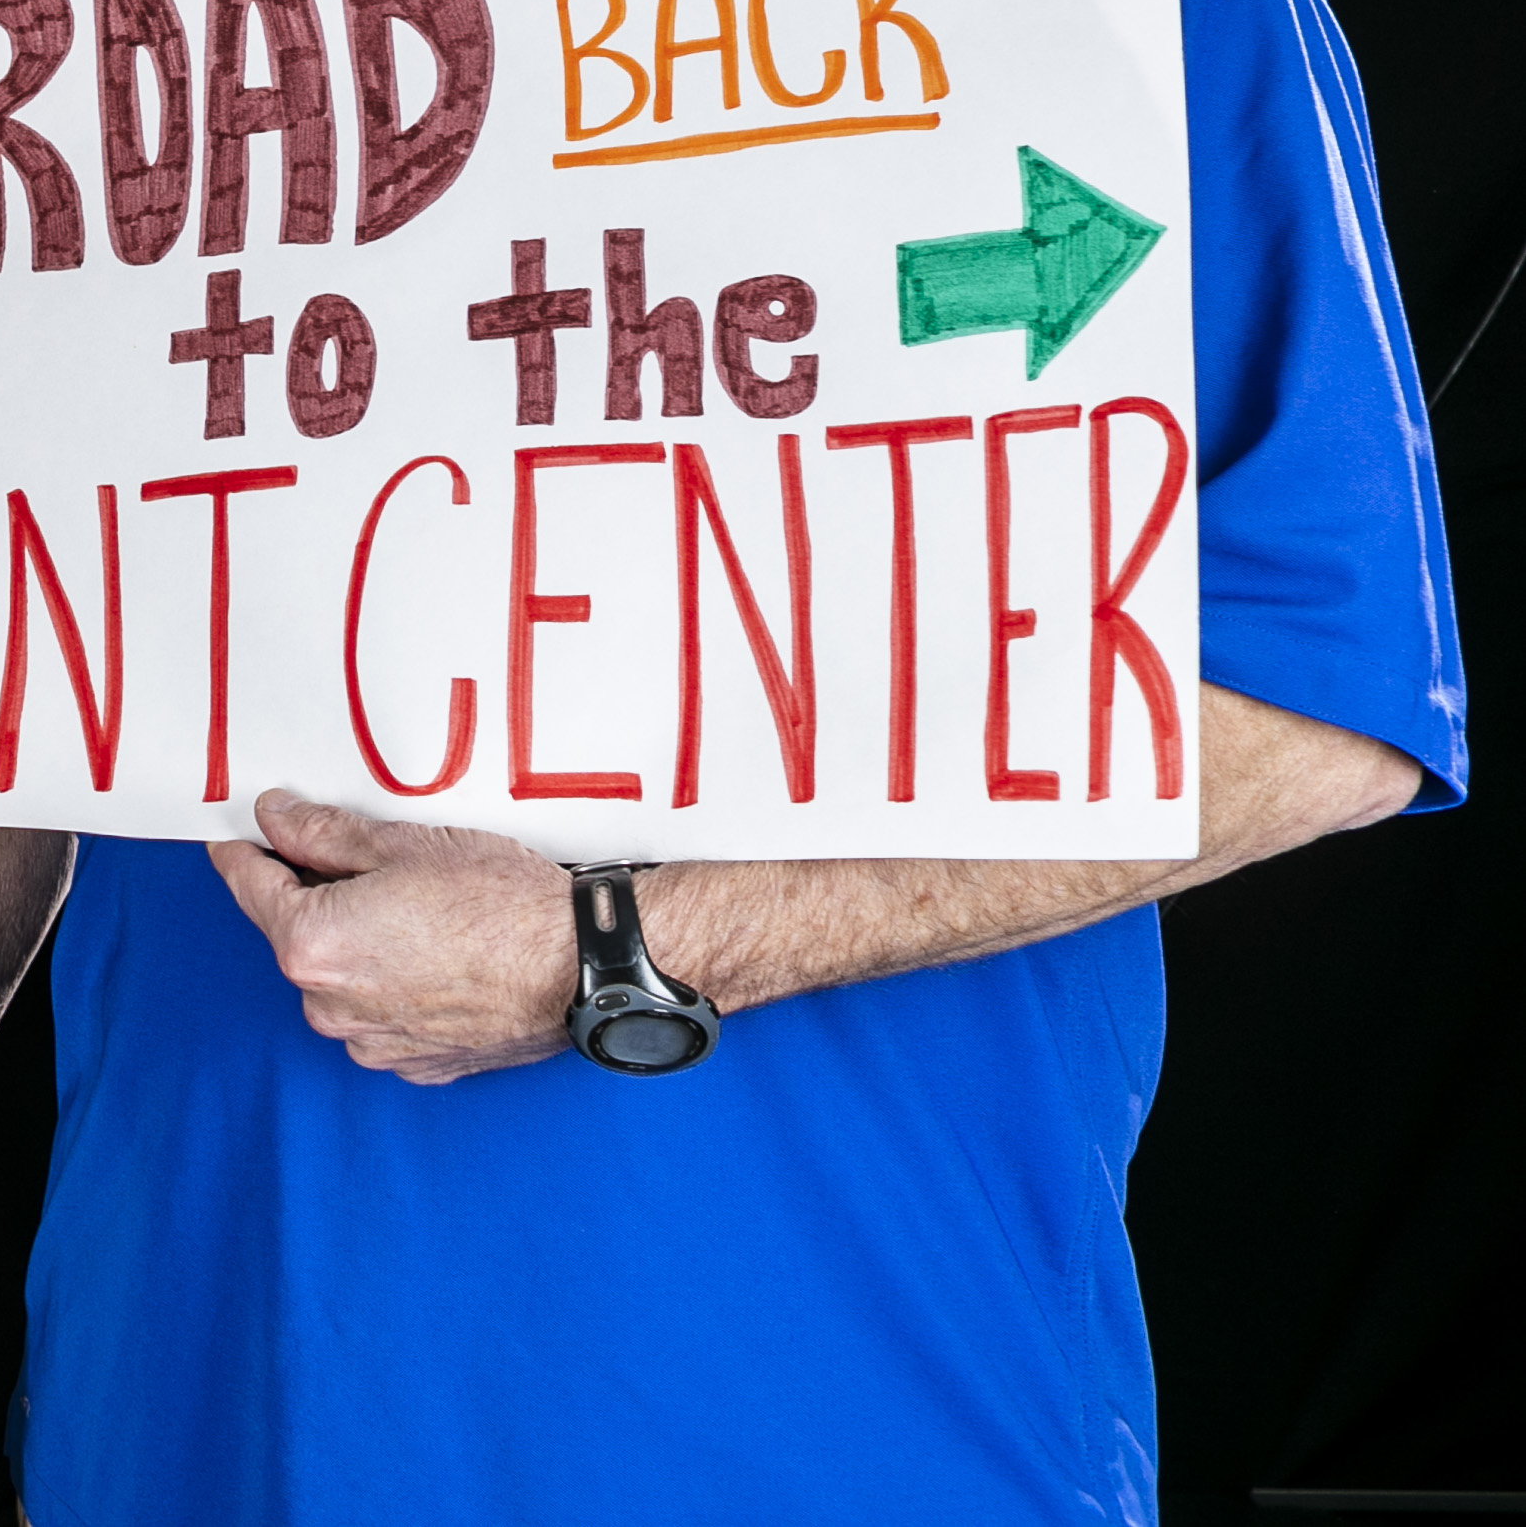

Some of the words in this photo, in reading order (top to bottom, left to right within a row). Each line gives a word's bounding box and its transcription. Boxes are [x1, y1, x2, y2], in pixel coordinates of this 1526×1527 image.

[170, 270, 375, 439] to
[468, 229, 819, 425] the
[344, 396, 1189, 807] CENTER
